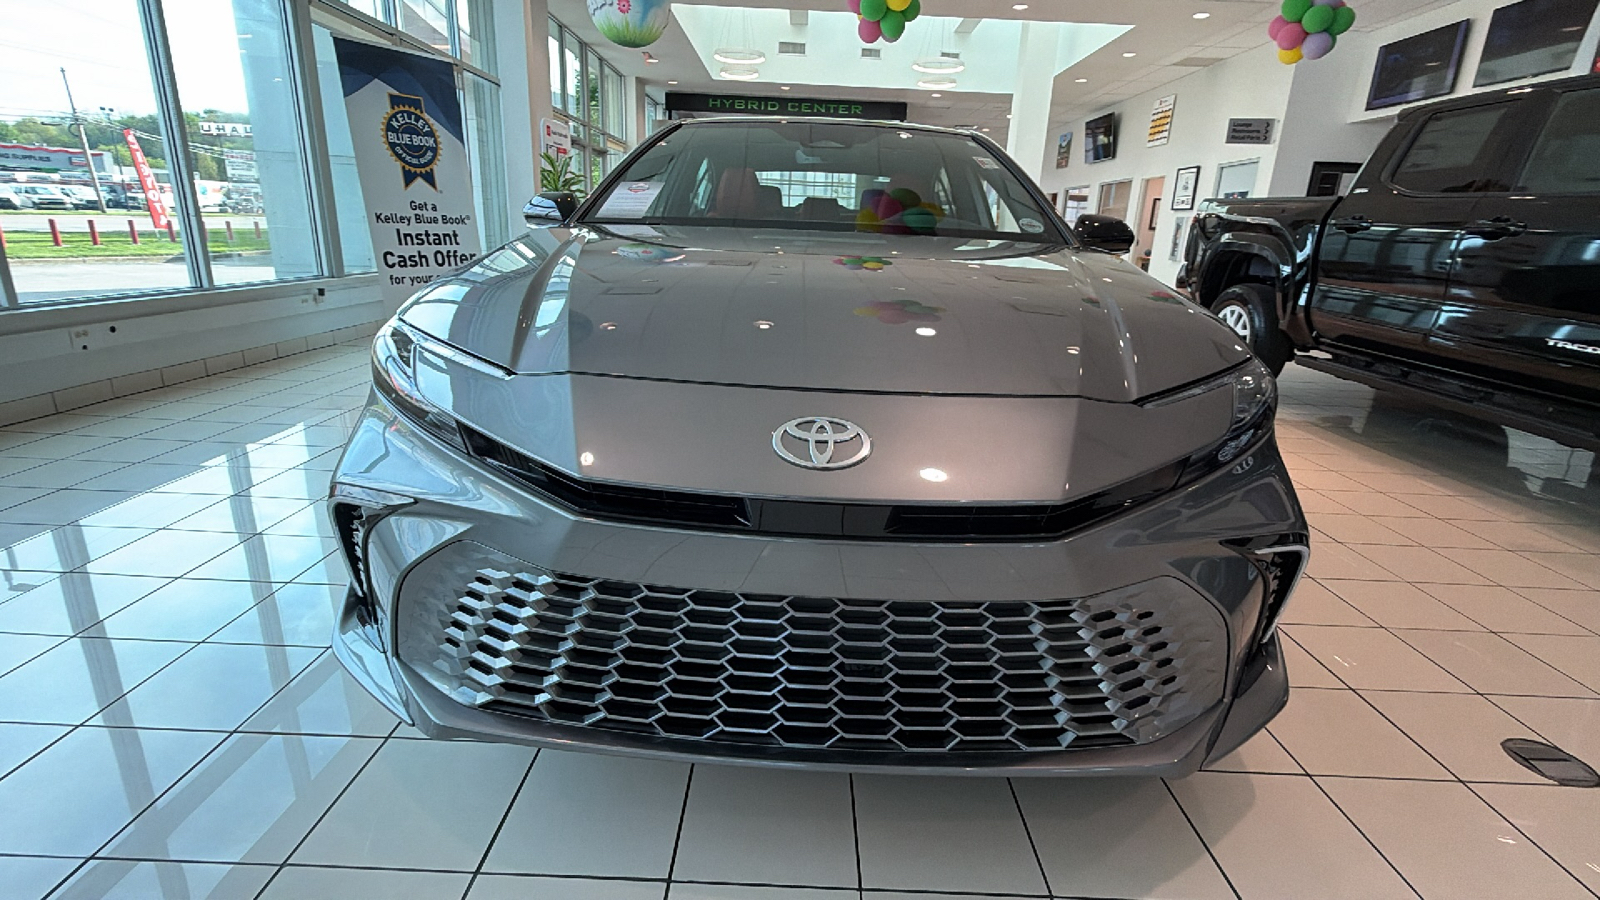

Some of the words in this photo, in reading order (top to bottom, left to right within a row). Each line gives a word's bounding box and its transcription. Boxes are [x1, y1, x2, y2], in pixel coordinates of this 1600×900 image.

[709, 98, 779, 111] HYBRID
[787, 102, 863, 114] CENTER
[390, 112, 430, 133] KELLEY
[387, 131, 412, 144] BLUE
[412, 134, 436, 147] BOOK
[394, 146, 420, 165] OFFICIAL
[410, 200, 429, 212] Get
[431, 203, 438, 212] a
[375, 212, 412, 226] Kelley
[414, 213, 439, 224] Blue
[395, 228, 460, 246] Instant
[382, 250, 430, 269] Cash
[433, 249, 477, 268] Offer
[389, 274, 406, 286] for
[409, 274, 434, 287] your
